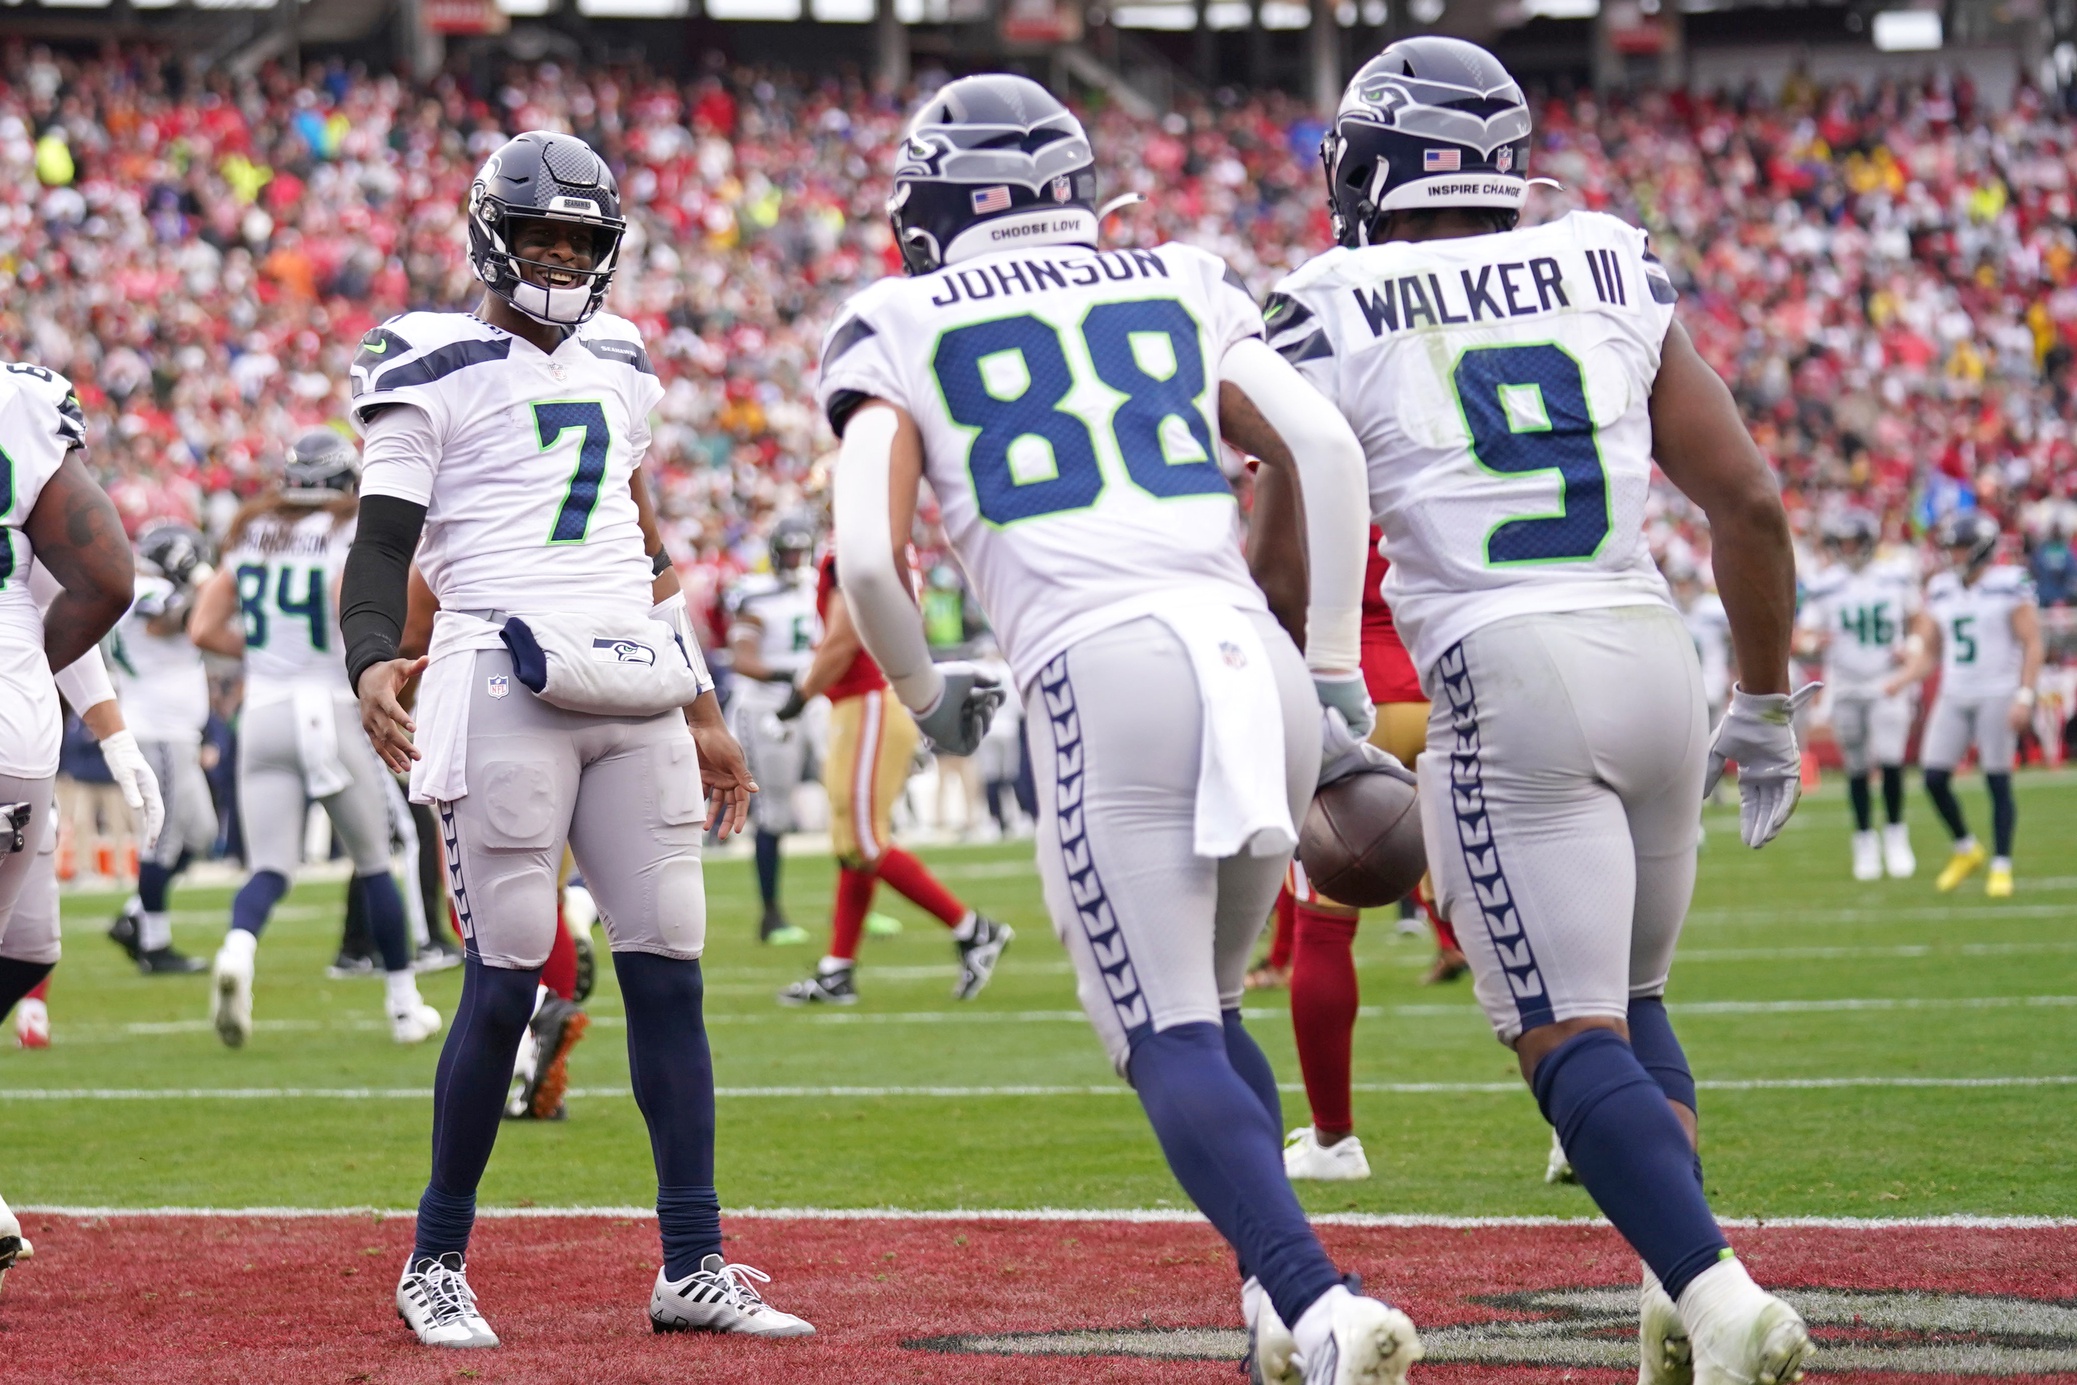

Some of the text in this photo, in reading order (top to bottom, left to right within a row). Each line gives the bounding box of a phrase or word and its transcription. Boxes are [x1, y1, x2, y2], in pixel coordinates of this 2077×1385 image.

[991, 220, 1081, 241] CHOOSE LOVE
[1428, 184, 1521, 198] INSPIRE CHANGE
[931, 249, 1170, 307] JOHNSON
[1352, 248, 1627, 338] WALKER III
[929, 294, 1238, 532] 88
[1448, 339, 1613, 569] 9
[529, 399, 613, 546] 7
[237, 563, 328, 652] 84
[1953, 615, 1978, 664] 5
